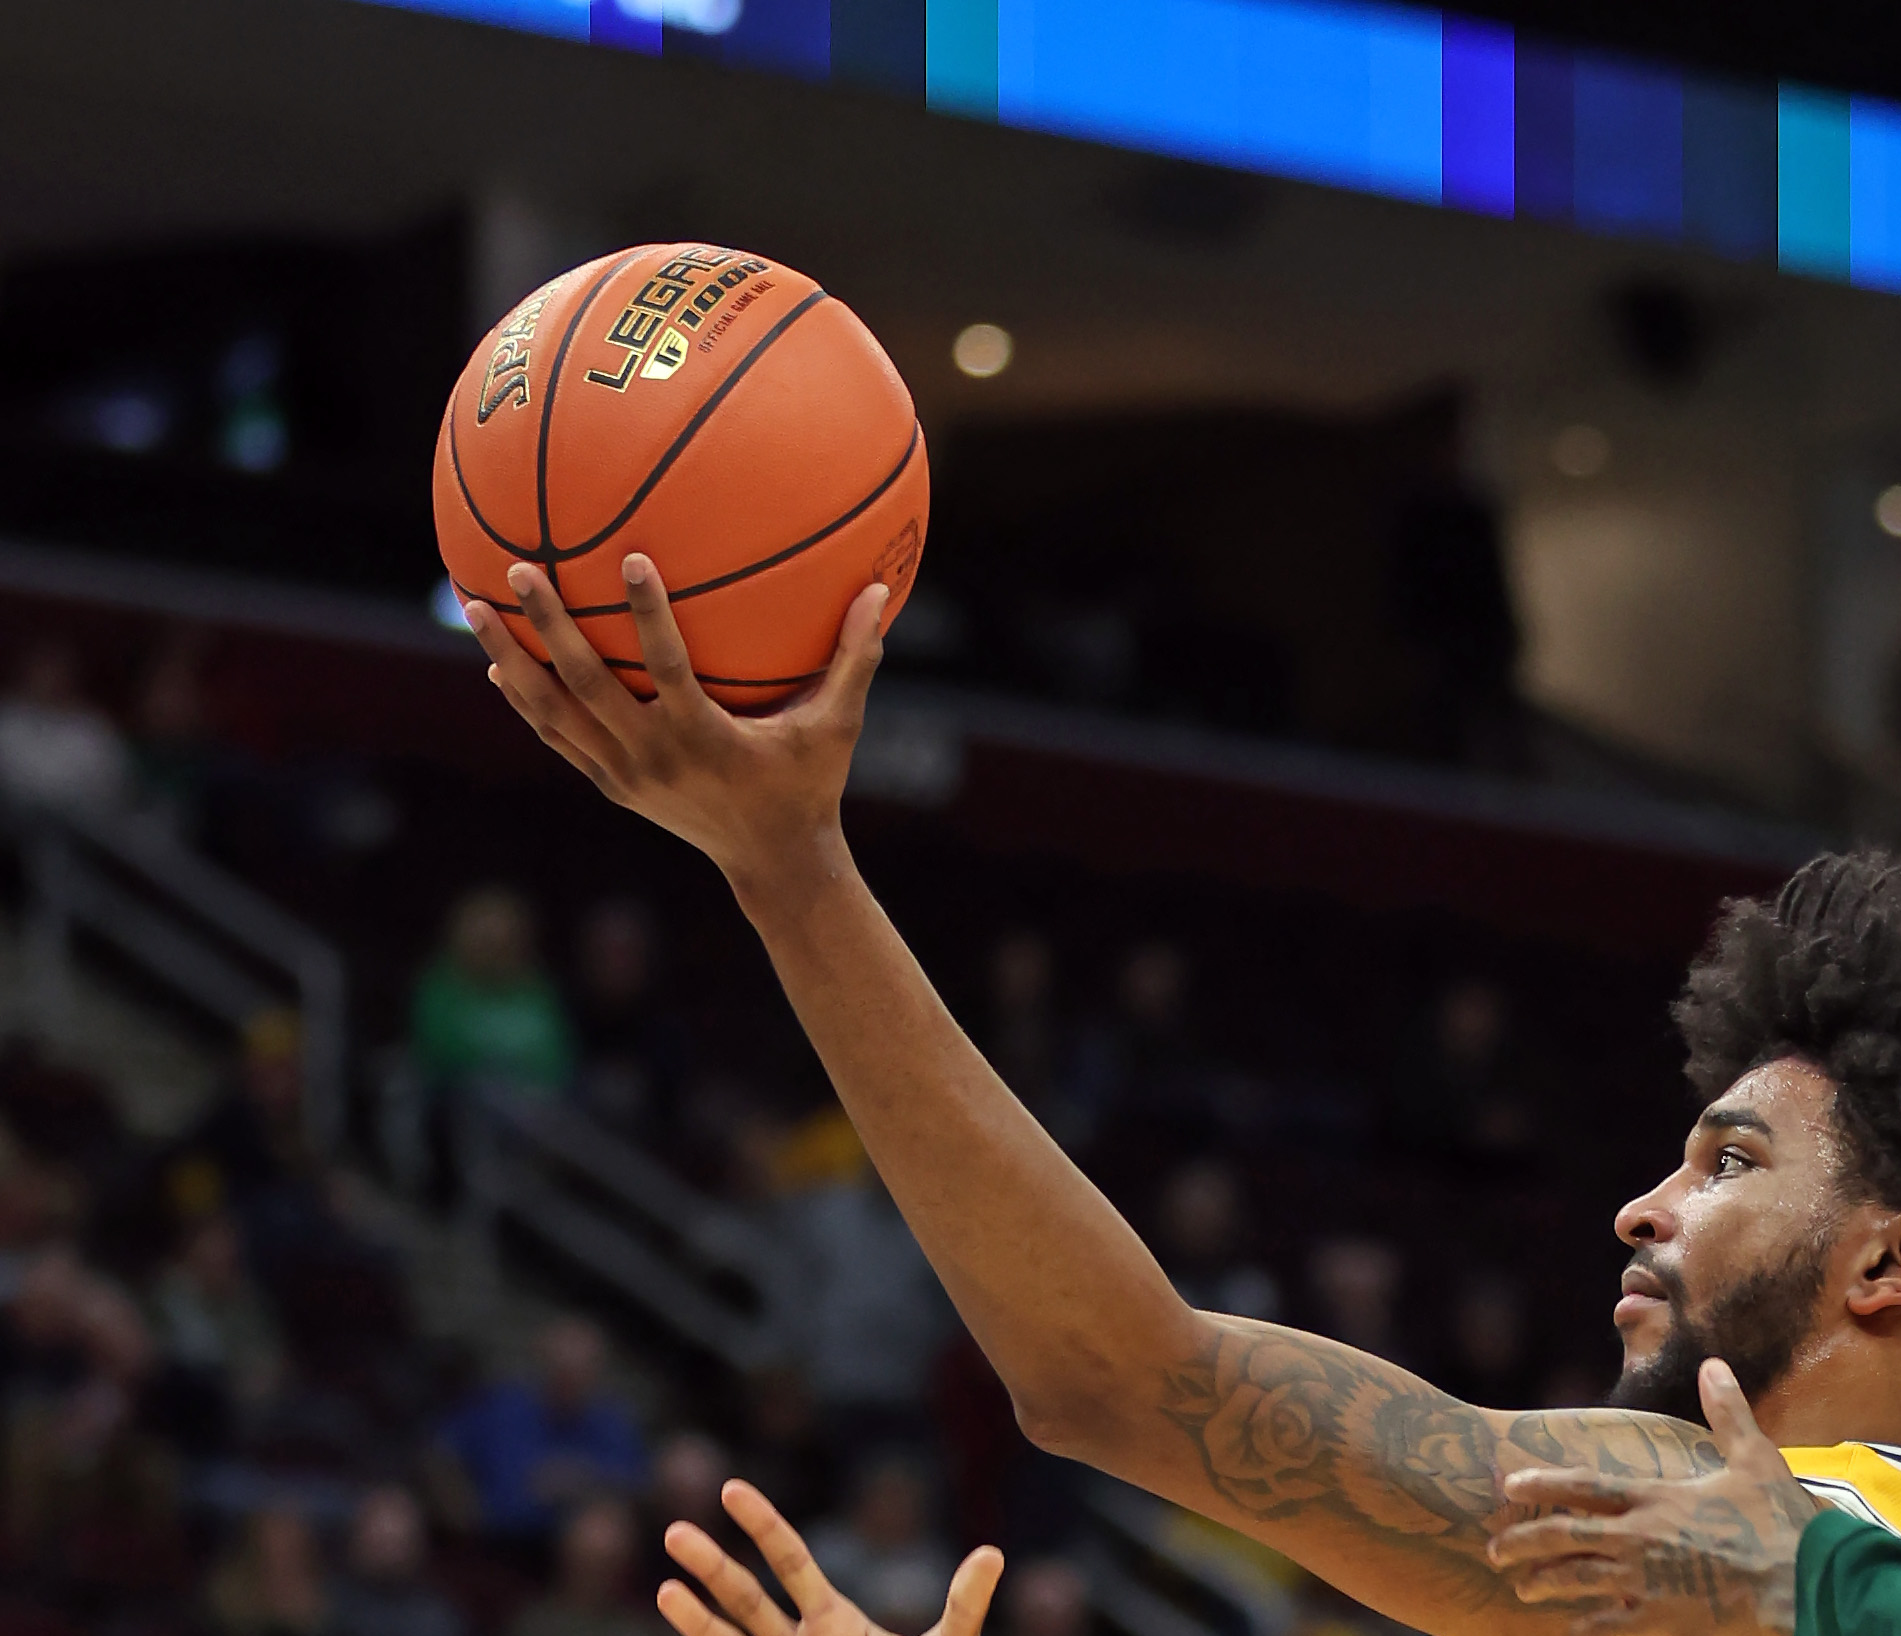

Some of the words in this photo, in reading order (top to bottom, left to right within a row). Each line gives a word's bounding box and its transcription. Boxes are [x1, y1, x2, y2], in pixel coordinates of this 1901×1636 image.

[584, 246, 742, 393] LEGAC
[697, 312, 739, 353] OFFICIAL
[730, 291, 760, 312] GAME
